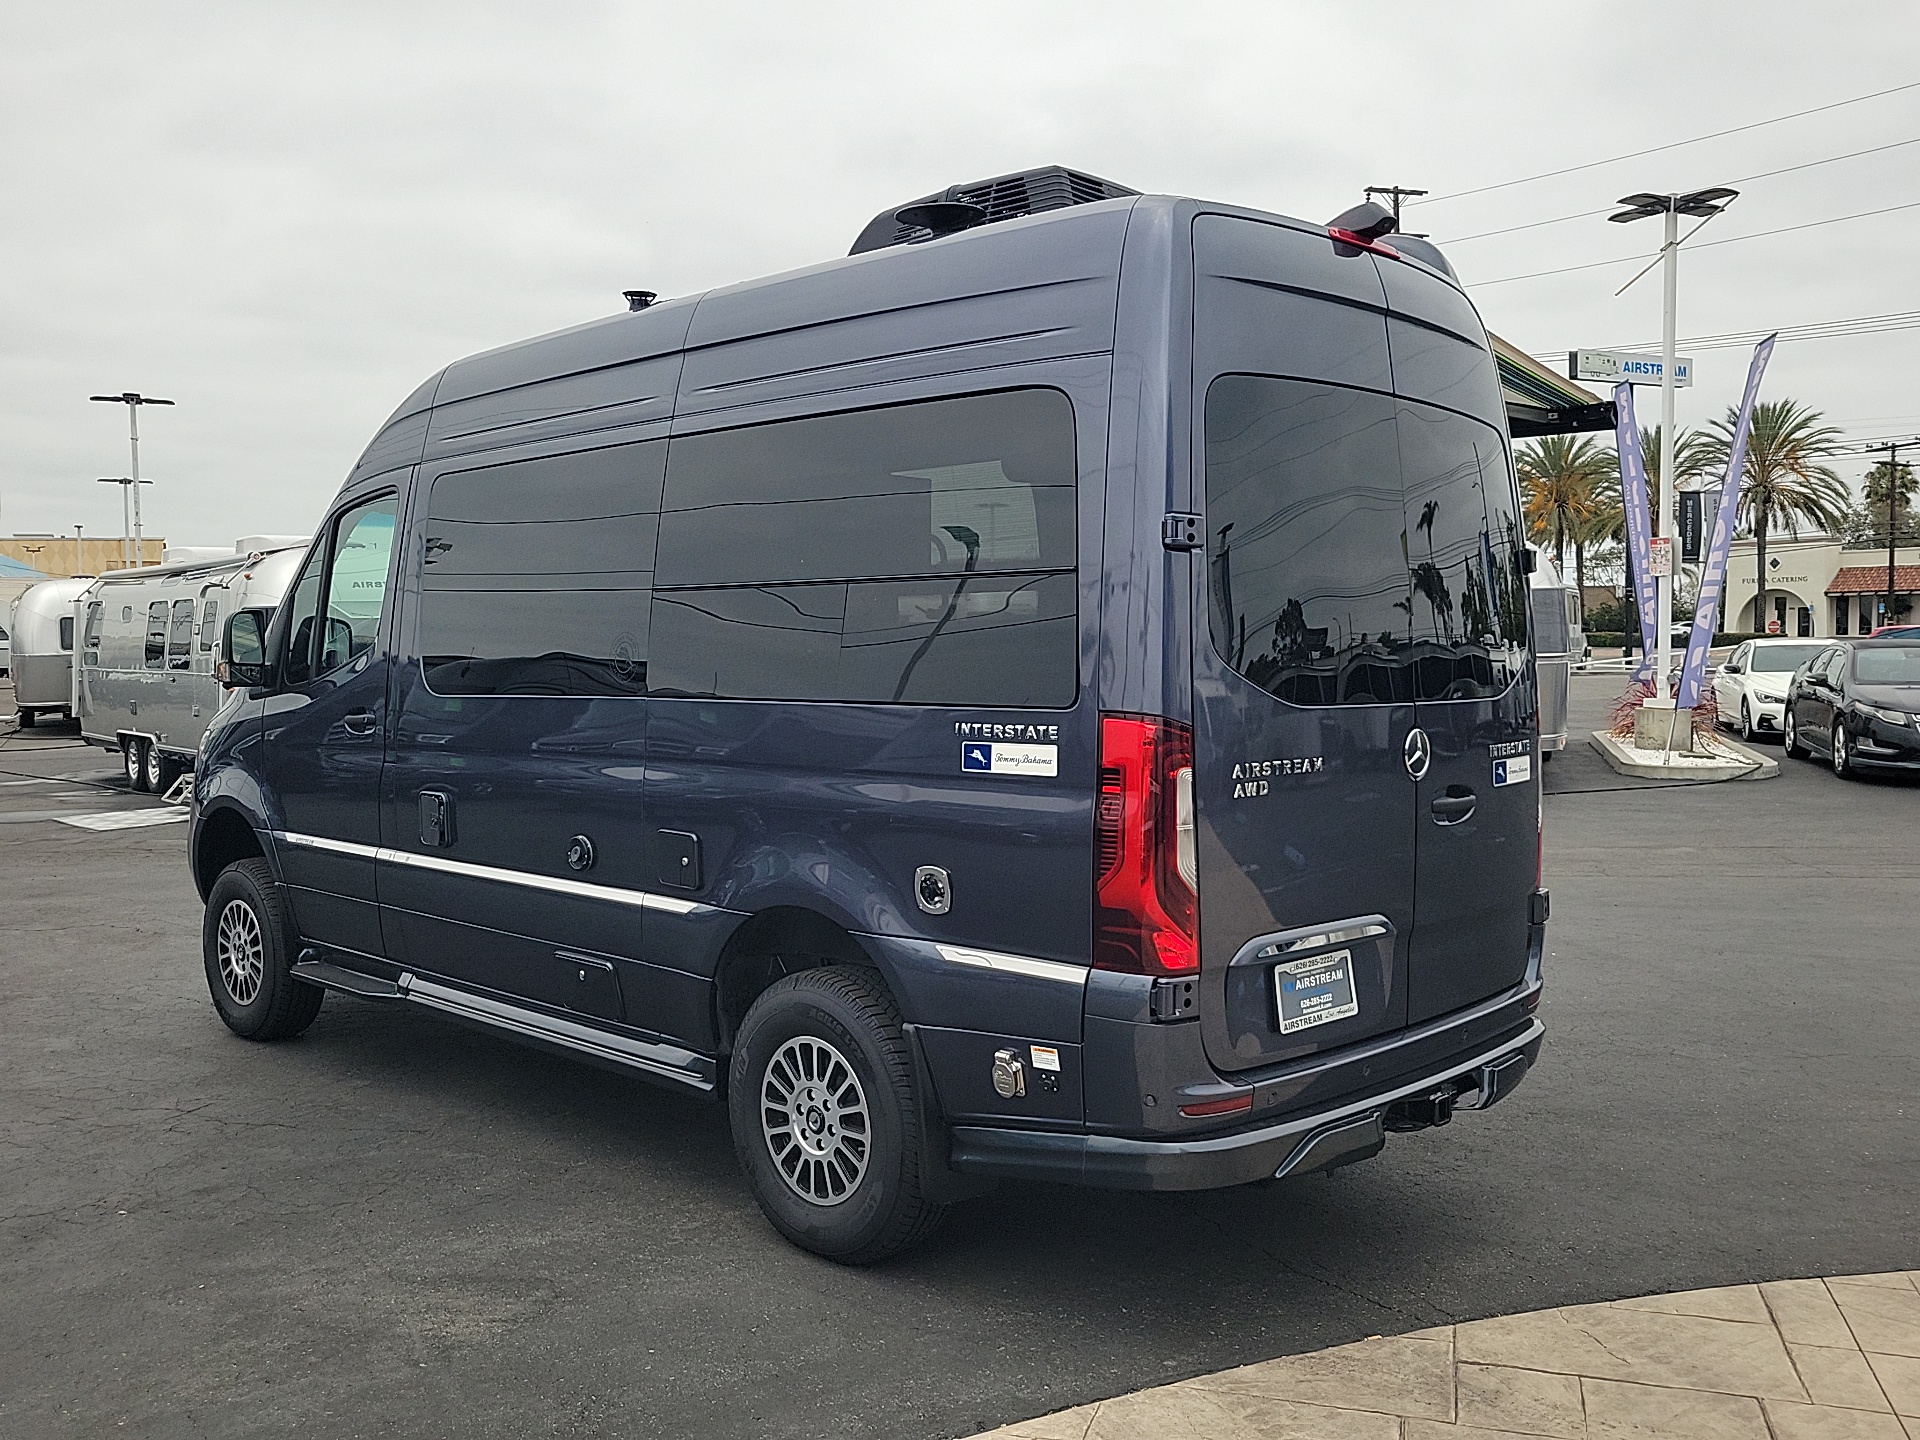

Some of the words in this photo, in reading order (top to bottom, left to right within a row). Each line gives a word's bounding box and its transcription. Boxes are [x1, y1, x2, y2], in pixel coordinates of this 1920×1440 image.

[1623, 361, 1687, 377] AIRSTRM
[954, 722, 1059, 740] INTERSTATE
[1489, 740, 1530, 757] INTERSTATE
[994, 753, 1020, 767] Tommy
[1020, 754, 1053, 765] Bahama
[1231, 756, 1324, 780] AIRSTREAM
[1233, 780, 1270, 799] AWD
[1295, 969, 1343, 990] AIRSTREAM
[1283, 1014, 1323, 1031] AIRSTREAM
